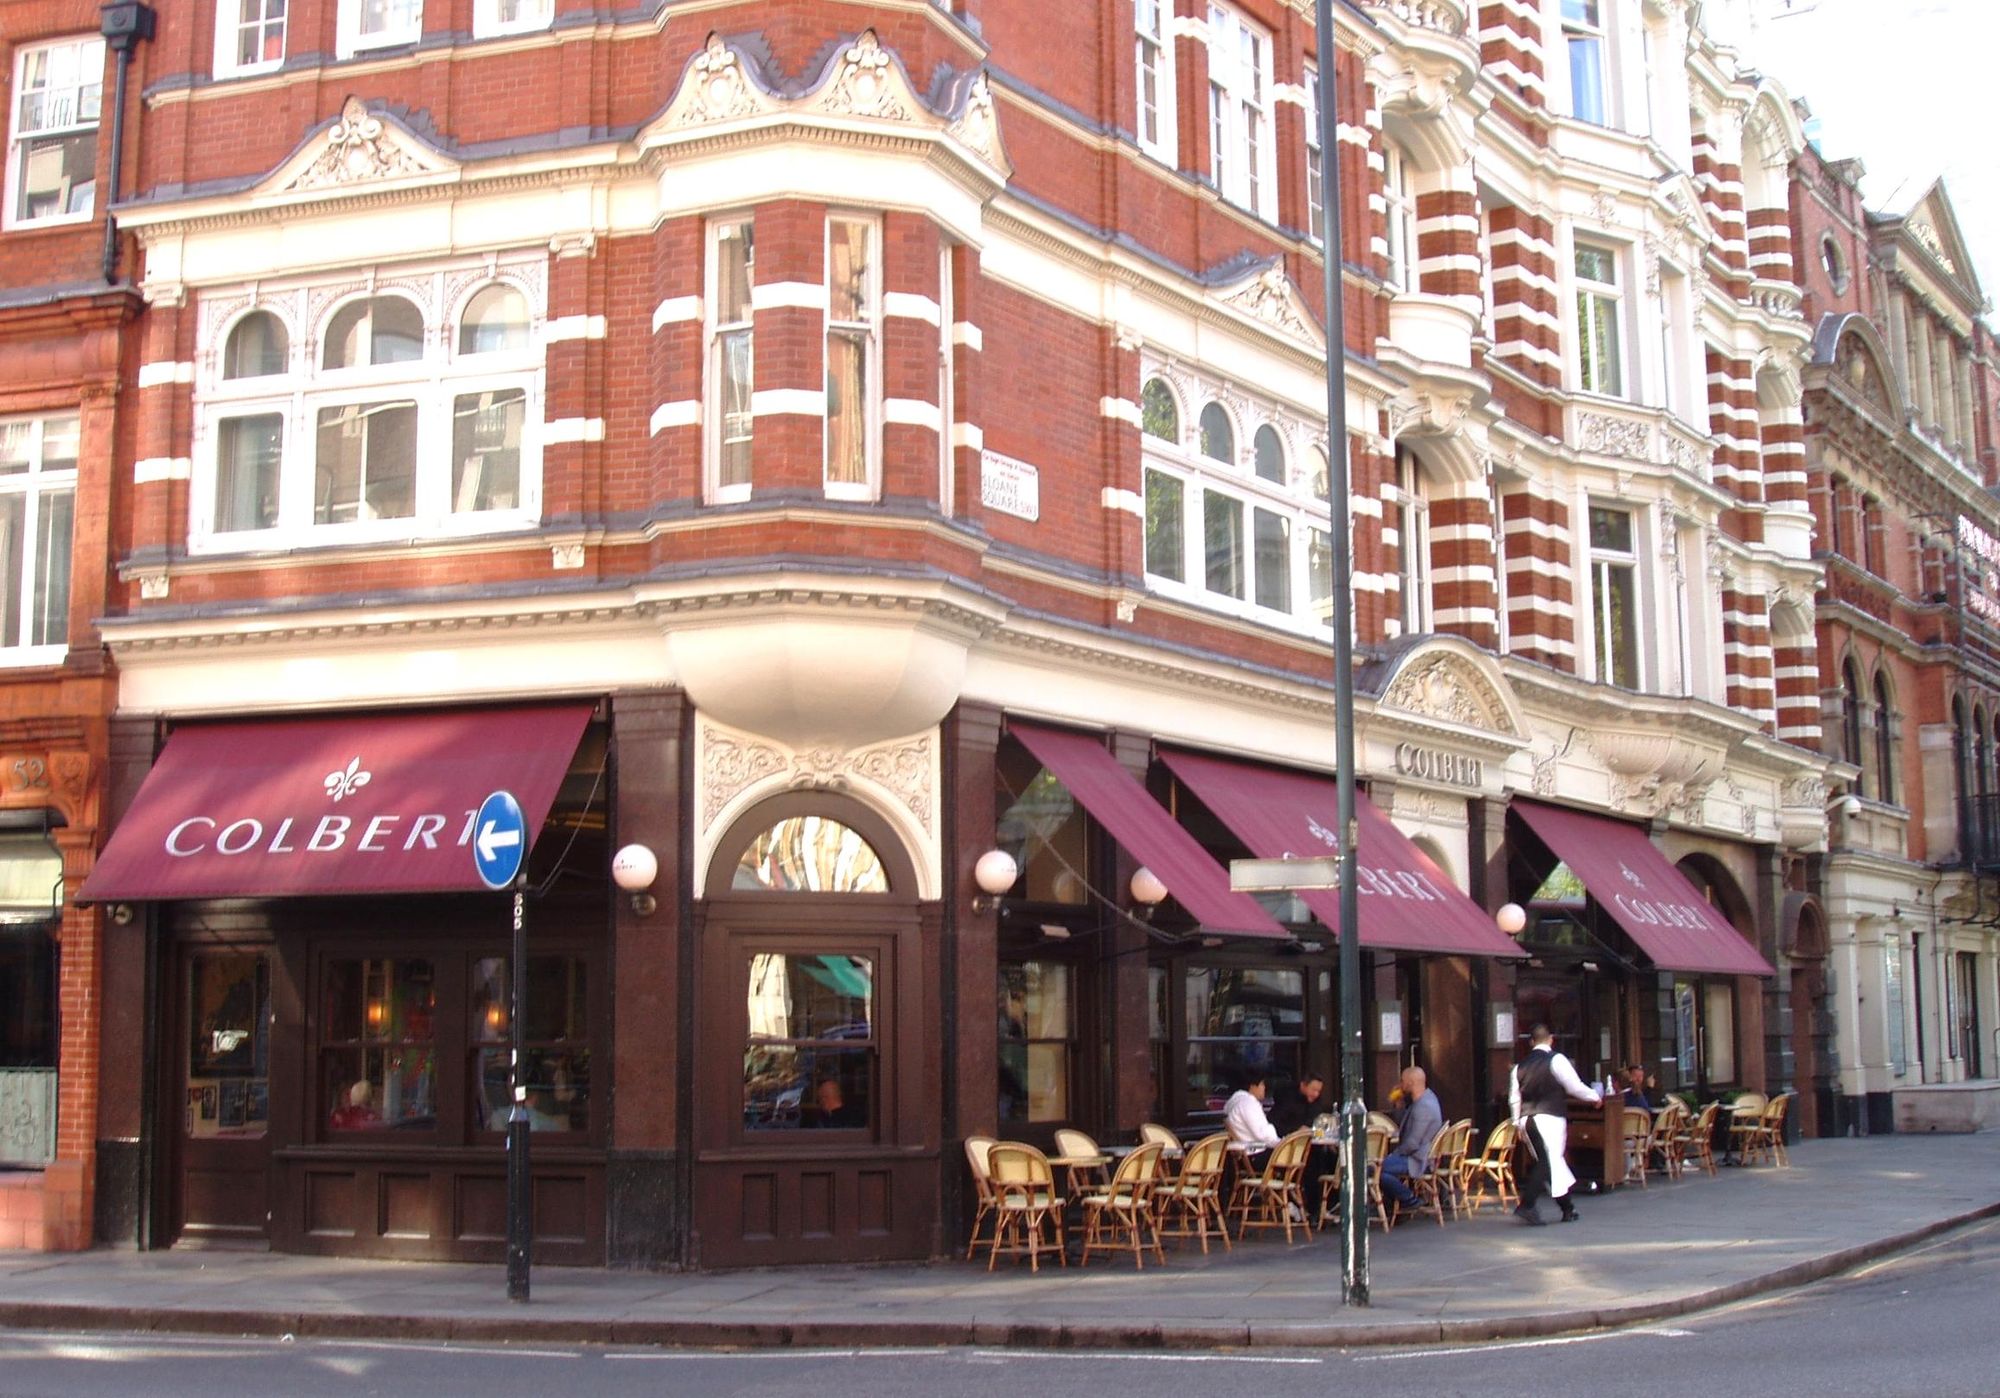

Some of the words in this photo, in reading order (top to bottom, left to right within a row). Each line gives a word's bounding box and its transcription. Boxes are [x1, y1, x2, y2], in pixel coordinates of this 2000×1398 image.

[13, 758, 49, 791] 52
[1394, 741, 1485, 787] COLBERT
[1613, 893, 1716, 930] COLBERT
